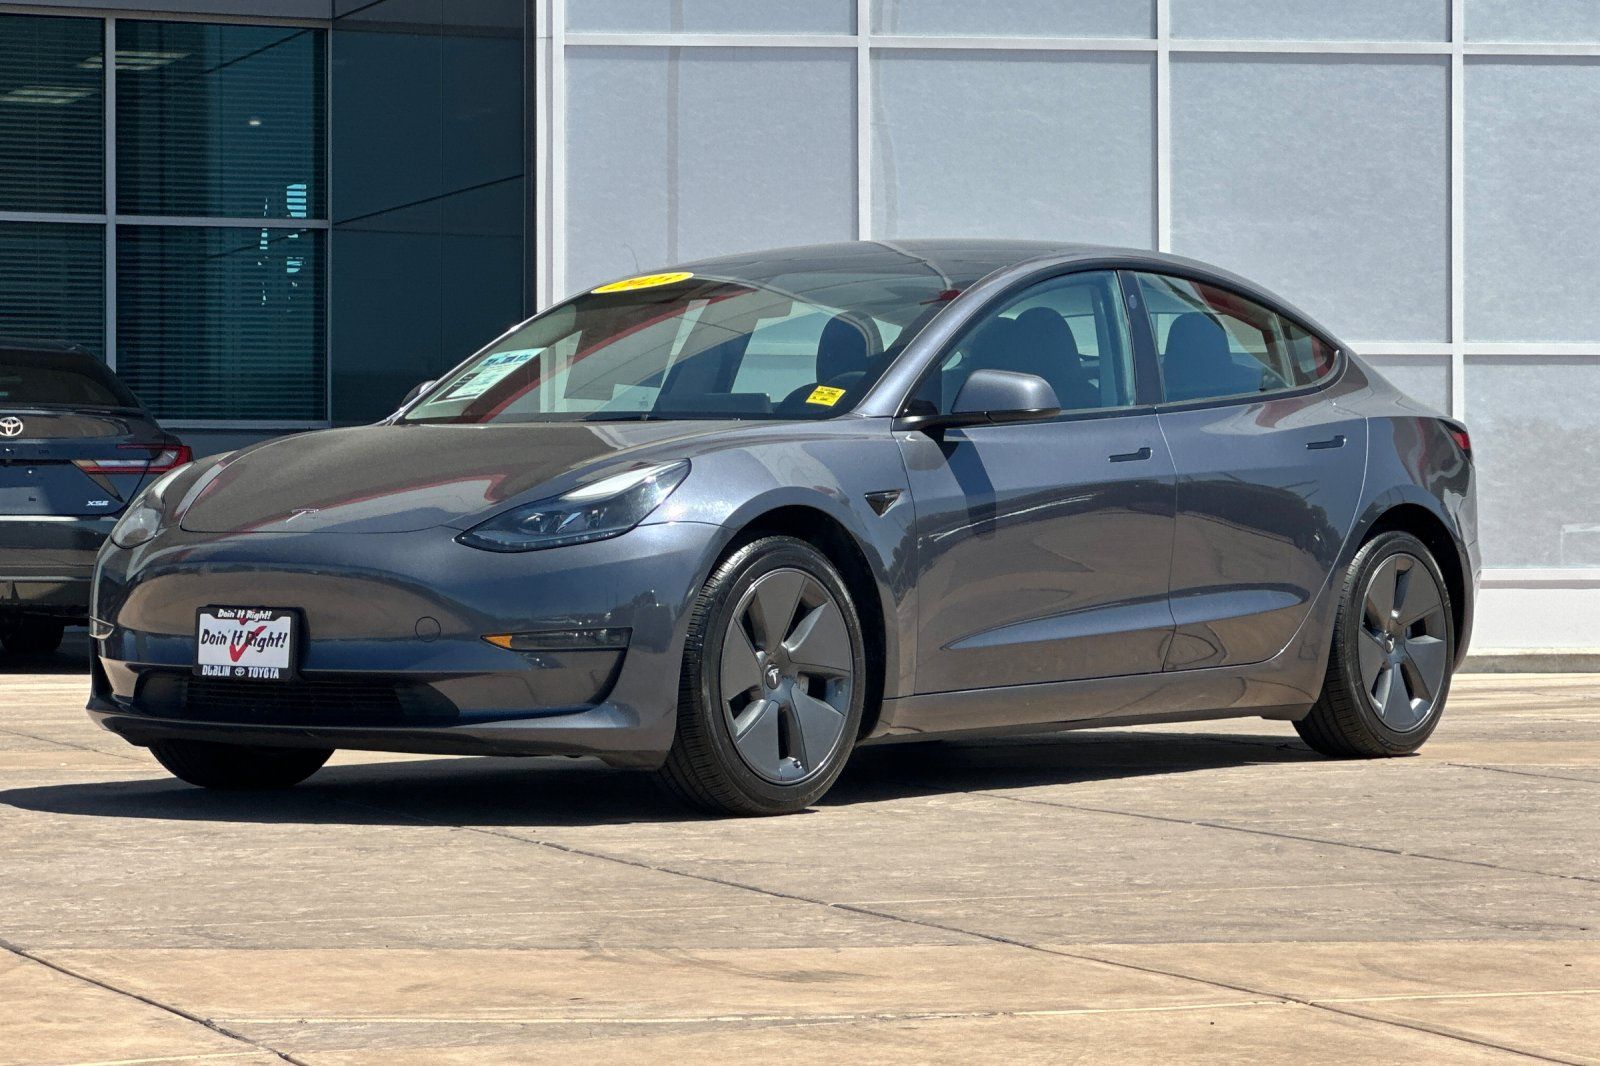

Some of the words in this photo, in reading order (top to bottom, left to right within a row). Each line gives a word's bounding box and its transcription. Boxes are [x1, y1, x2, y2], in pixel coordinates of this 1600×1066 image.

[217, 608, 236, 619] Doin'
[236, 609, 246, 619] It
[246, 609, 272, 622] Right!
[200, 628, 231, 645] Doin'
[231, 630, 244, 646] It
[245, 630, 288, 653] Right!
[202, 664, 231, 677] DUBLIN
[247, 667, 280, 679] TOYOTA
